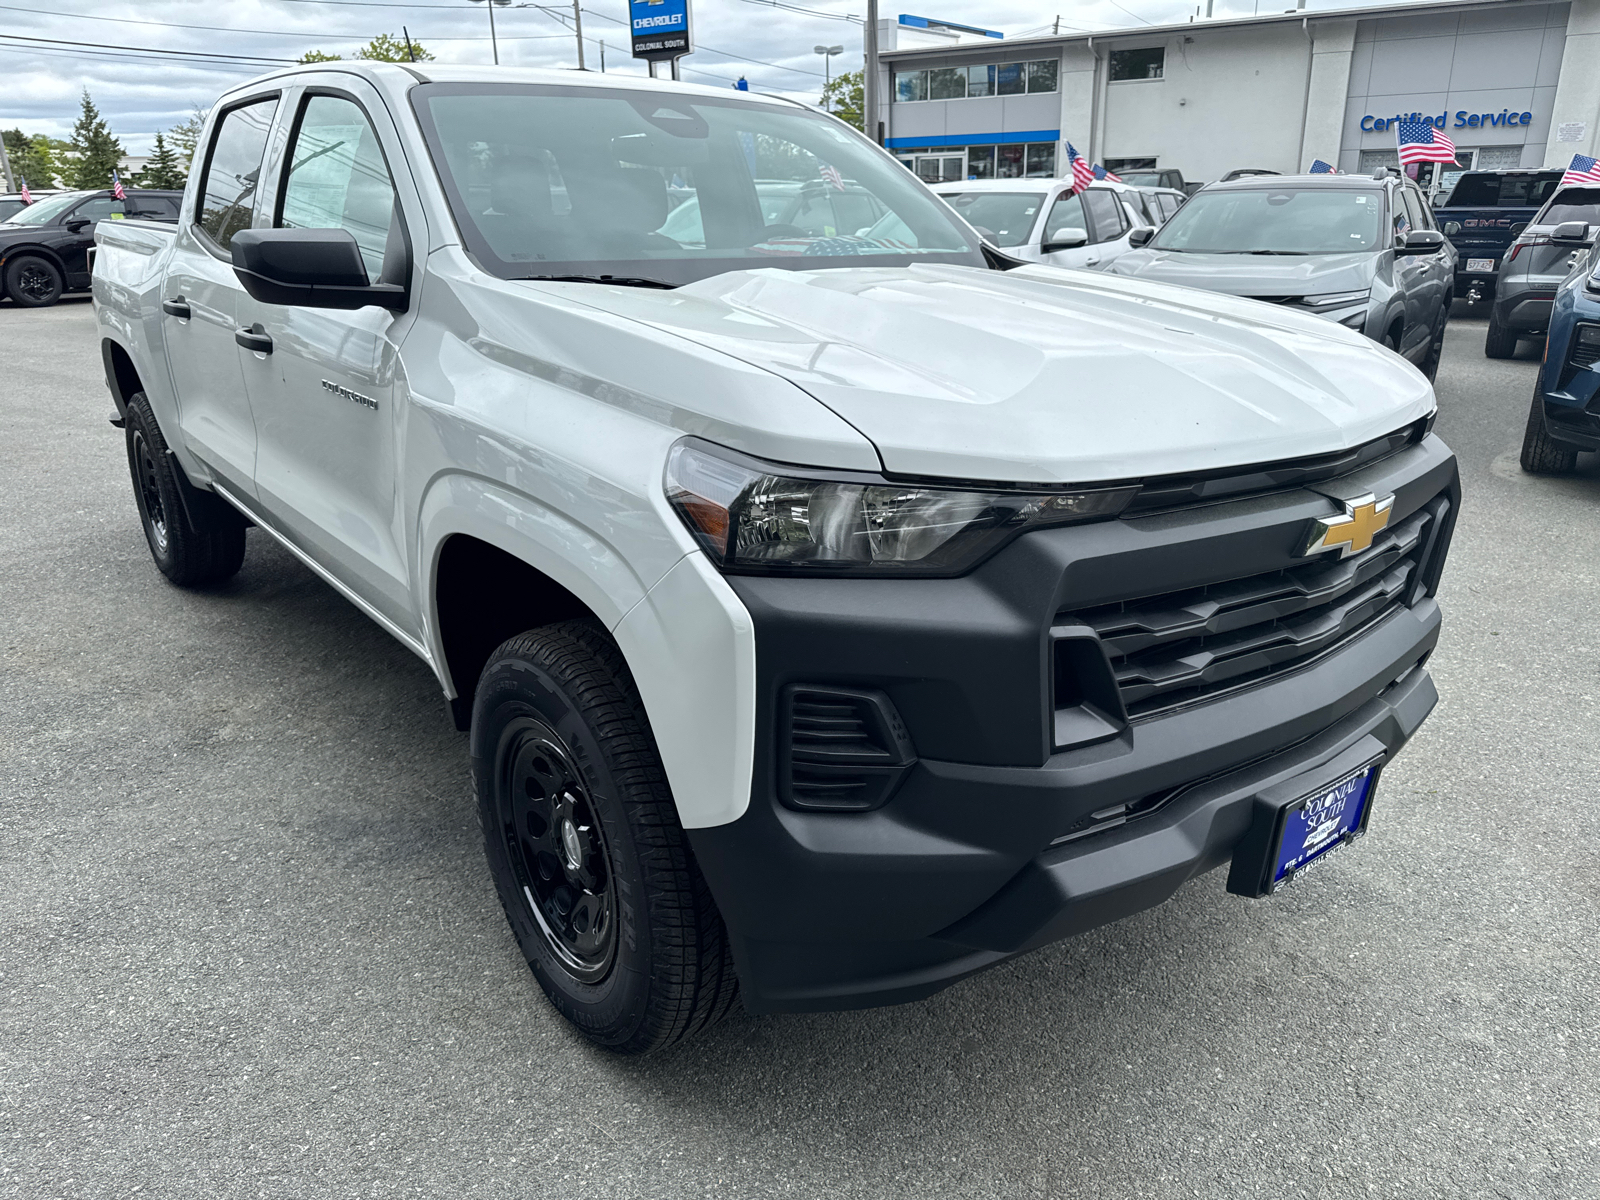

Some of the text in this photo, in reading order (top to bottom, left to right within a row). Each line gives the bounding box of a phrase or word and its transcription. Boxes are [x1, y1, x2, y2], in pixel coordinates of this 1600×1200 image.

[633, 13, 683, 29] CHEVROLET
[635, 39, 685, 52] COLONIAL SOUTH
[1453, 108, 1533, 128] Service
[1464, 219, 1511, 228] GMC
[321, 378, 379, 411] COLORADO
[1301, 778, 1357, 820] COLONIAL
[1305, 797, 1347, 832] SOUTH
[1307, 821, 1337, 843] CHEVROLET
[1293, 856, 1326, 881] COLONIAL
